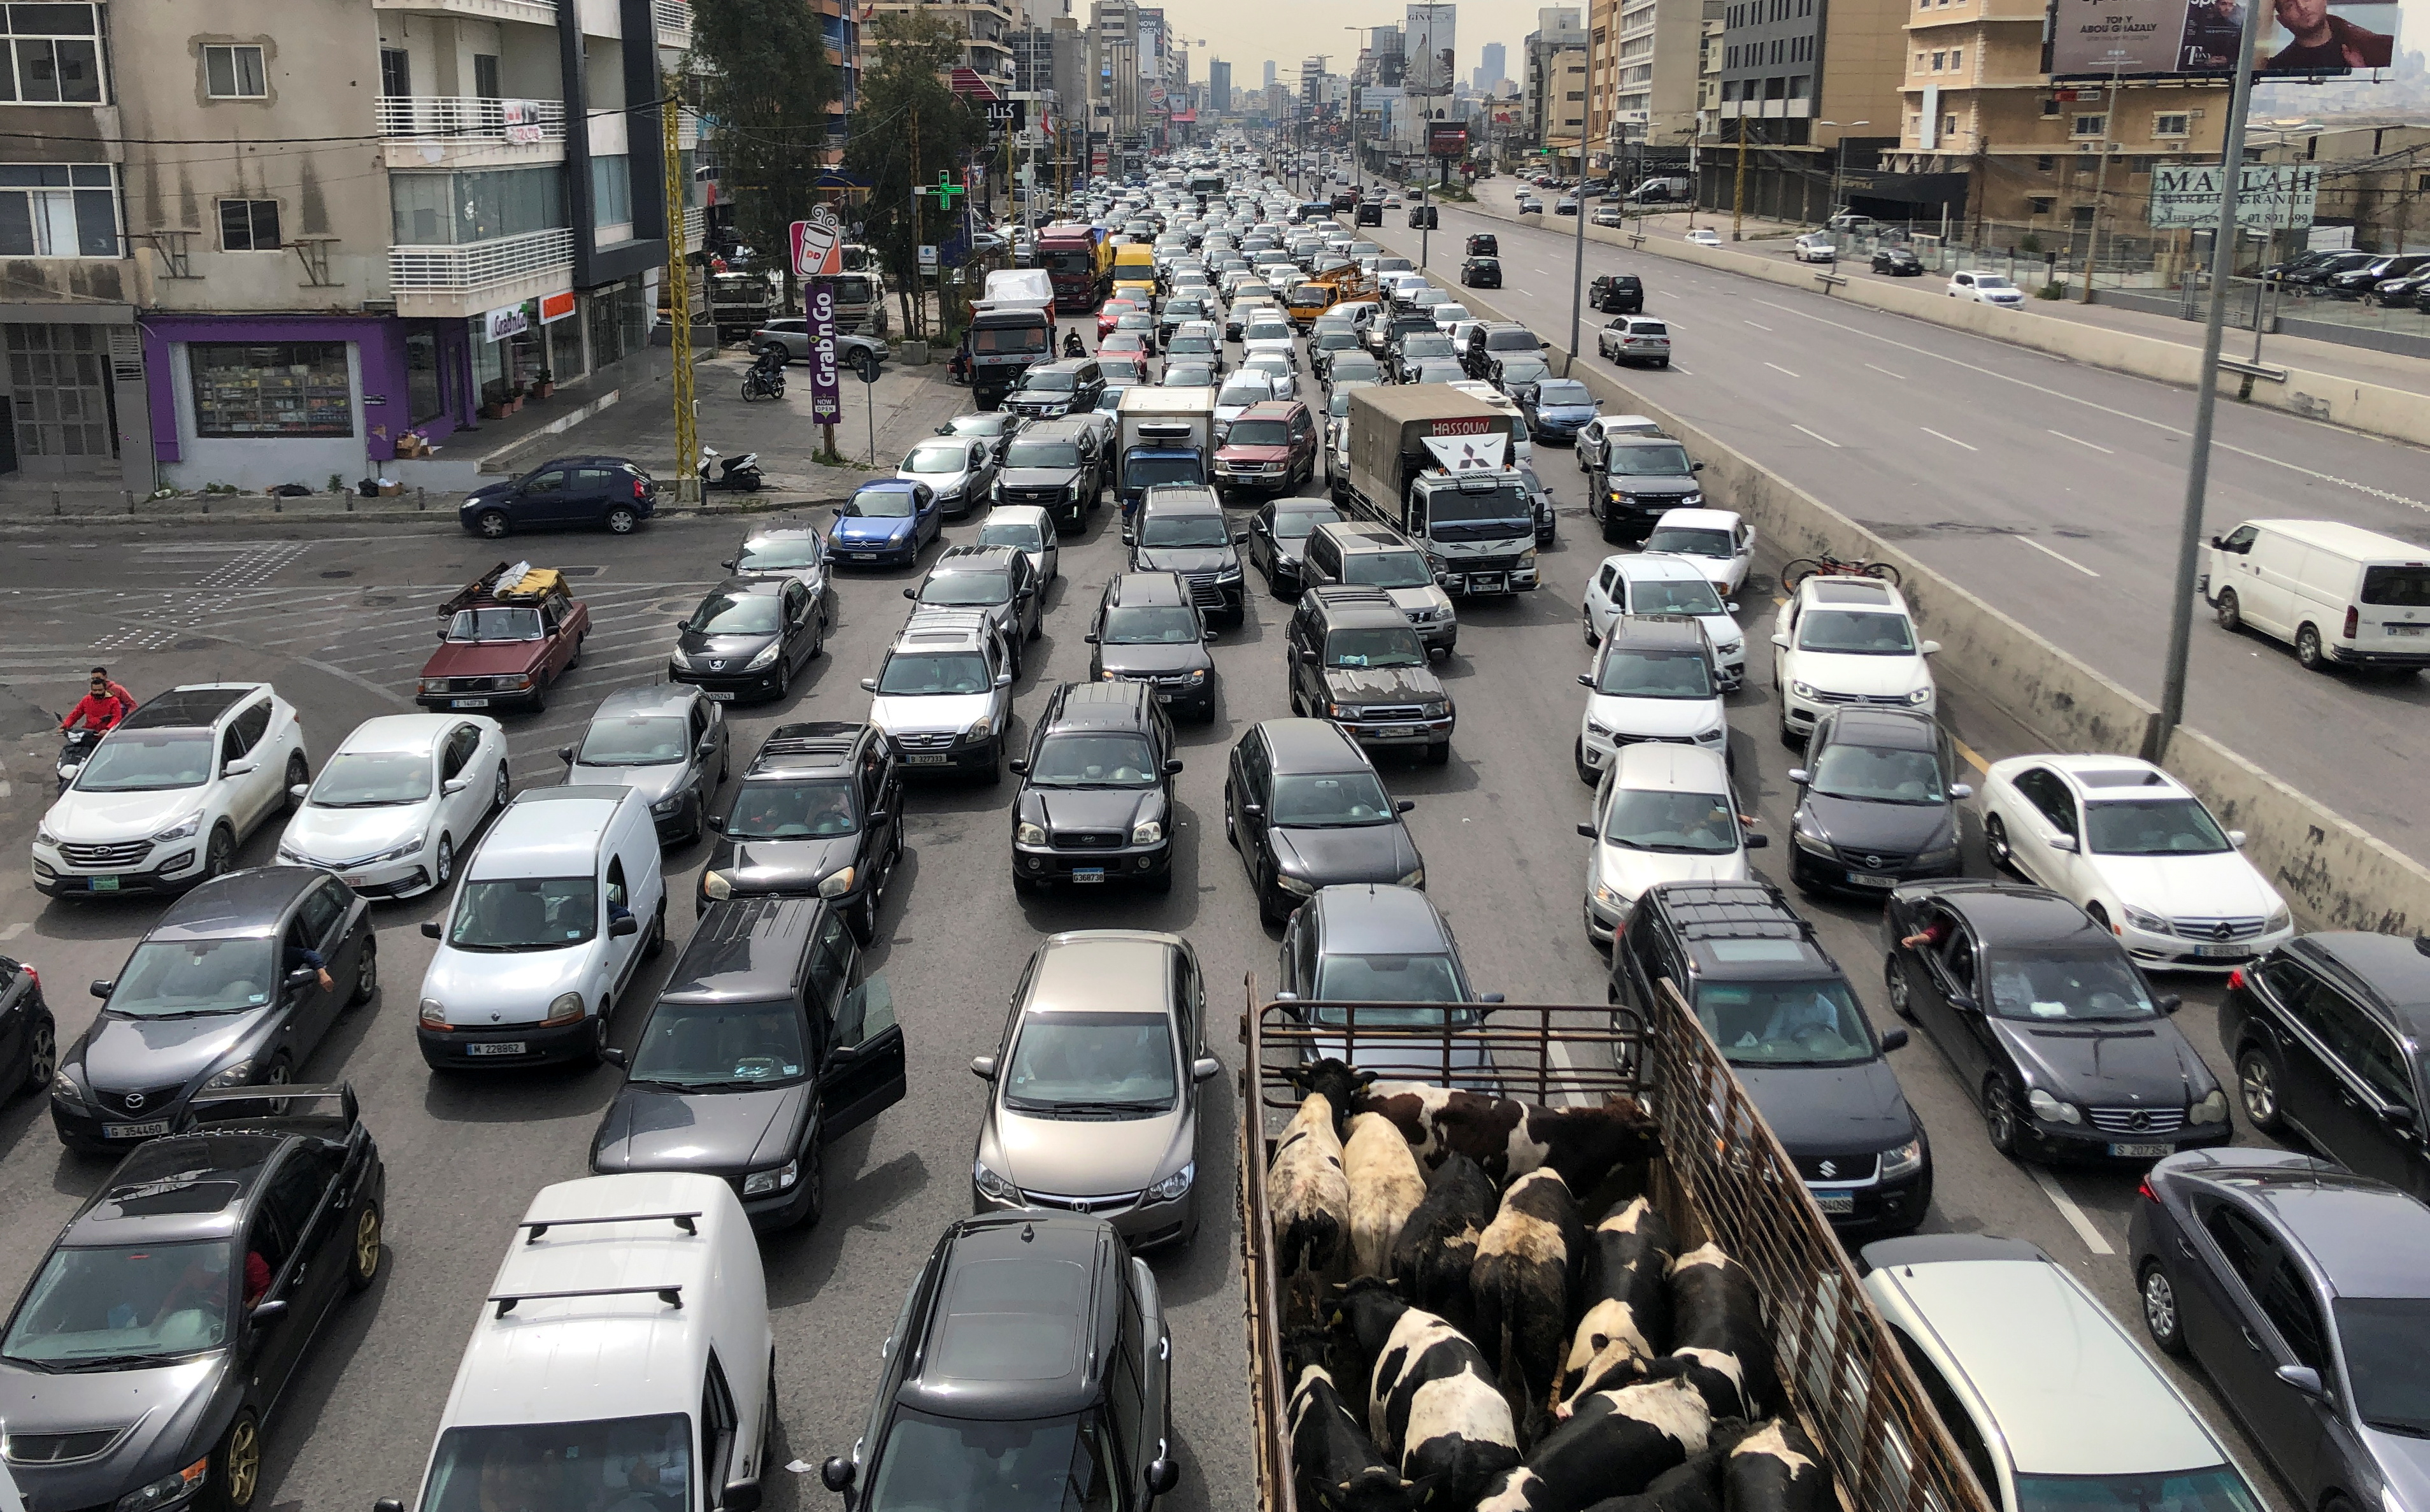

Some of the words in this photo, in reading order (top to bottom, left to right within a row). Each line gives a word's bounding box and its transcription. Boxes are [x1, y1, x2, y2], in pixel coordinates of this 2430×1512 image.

[1061, 135, 1084, 143] CNDY
[2159, 171, 2315, 192] MALAH
[806, 250, 821, 260] DD
[1432, 421, 1490, 436] HASSOUN
[111, 1128, 118, 1137] G
[124, 1125, 161, 1136] 354460
